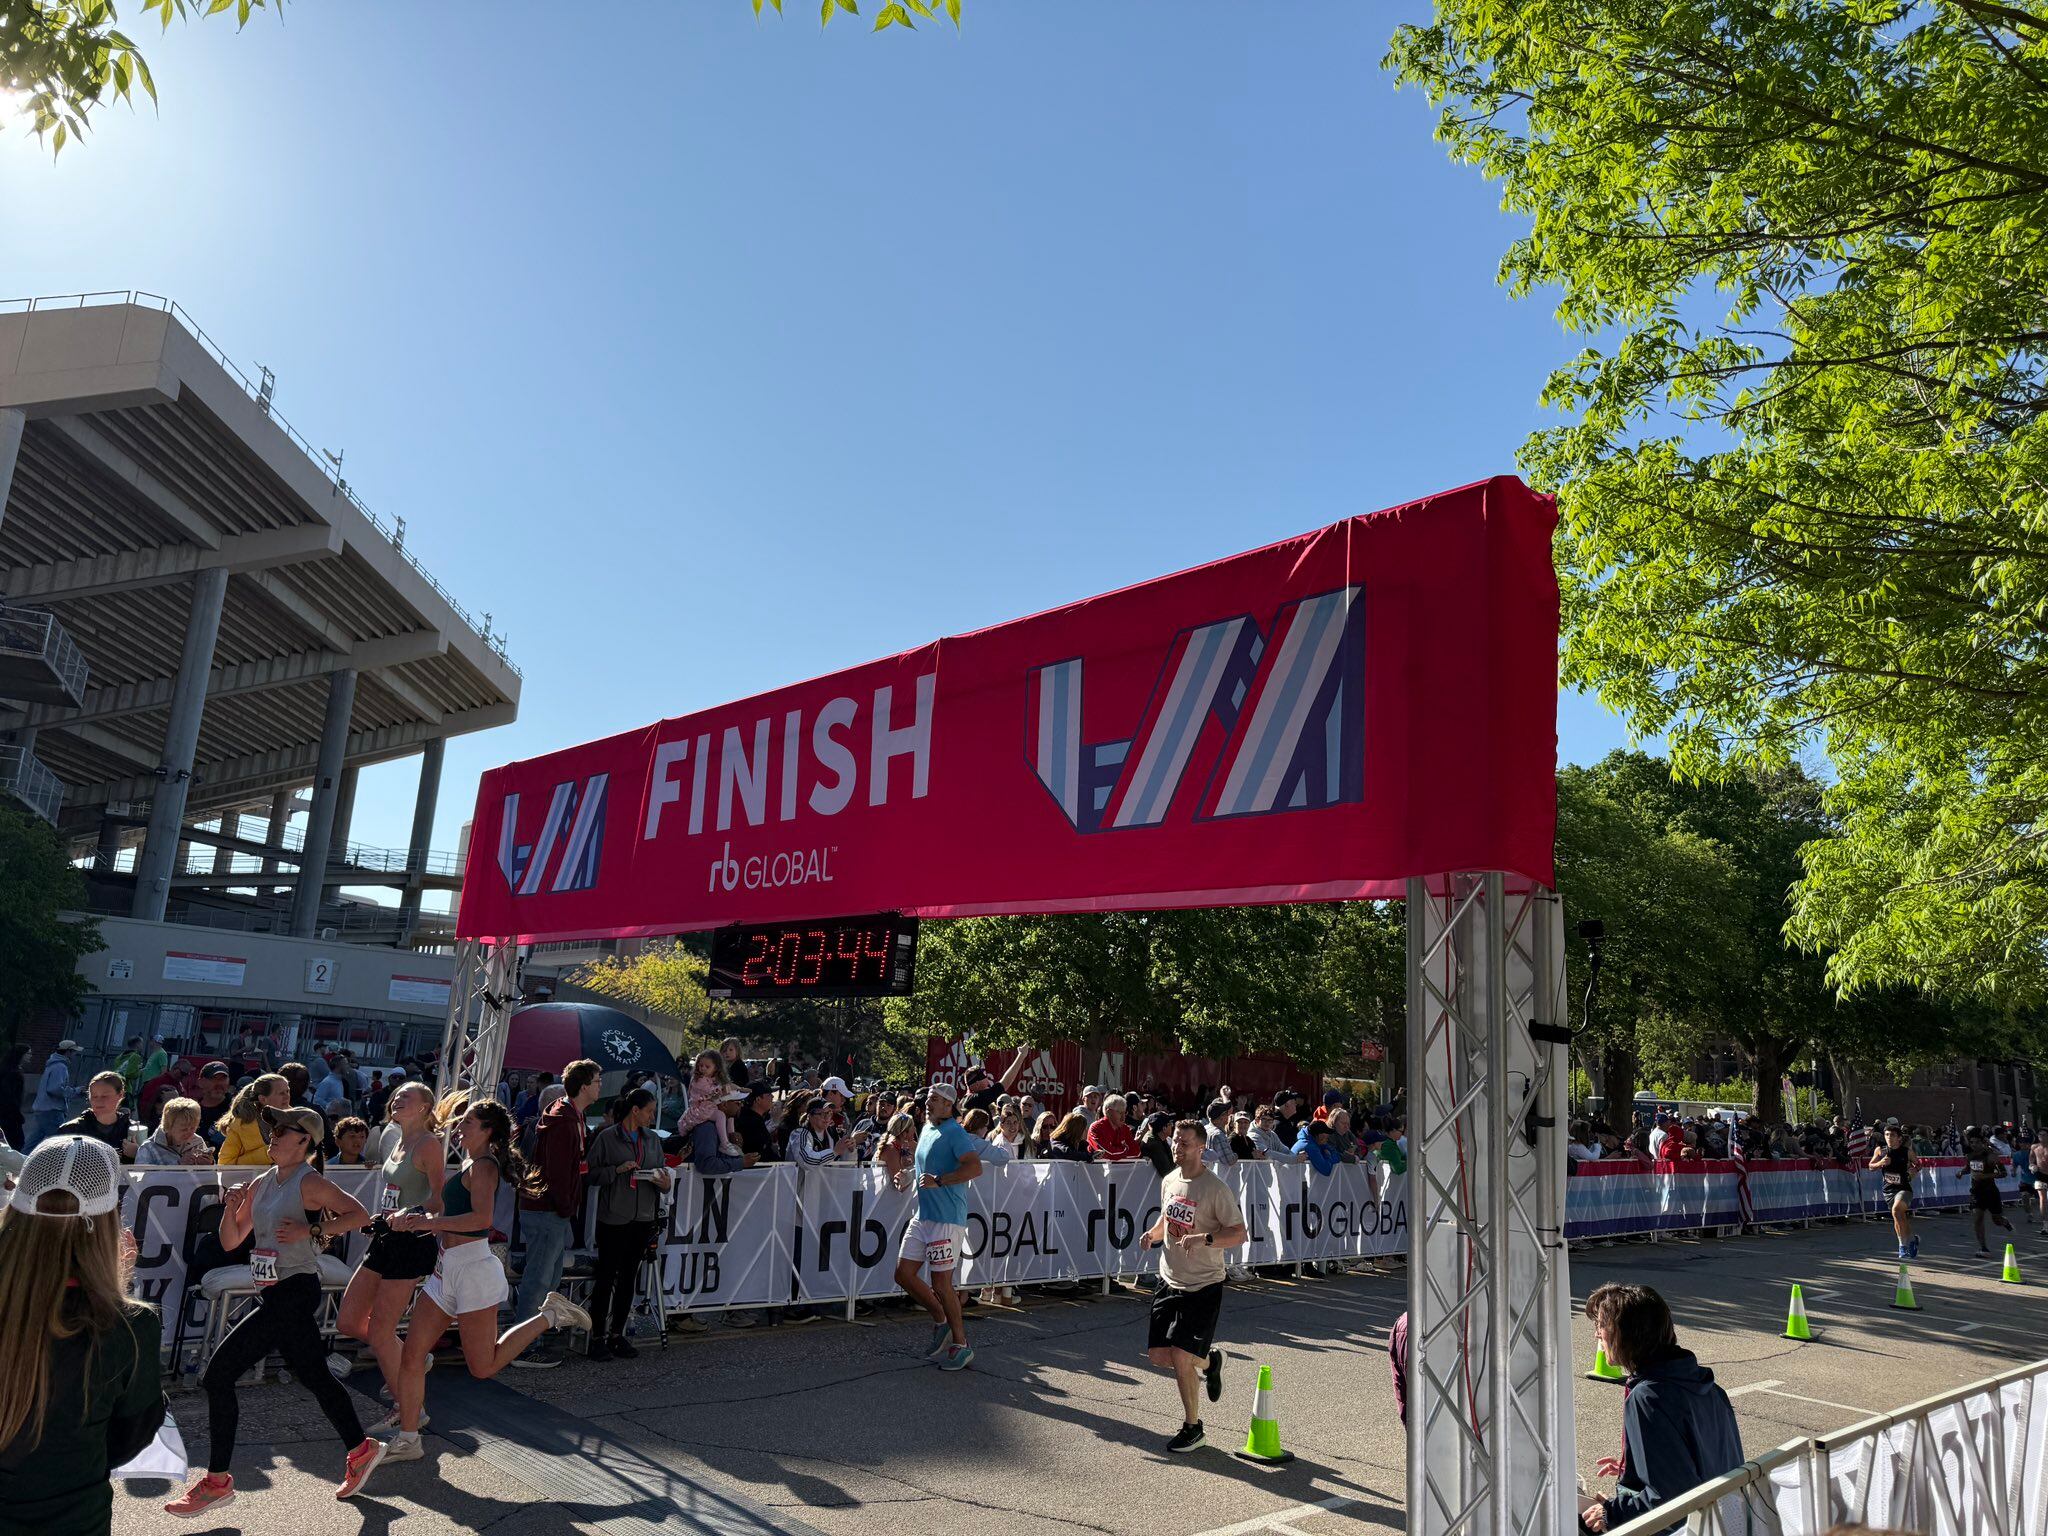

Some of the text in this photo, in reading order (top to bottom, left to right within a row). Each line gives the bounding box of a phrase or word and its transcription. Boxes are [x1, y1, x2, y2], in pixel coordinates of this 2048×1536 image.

[643, 671, 937, 841] FINISH
[708, 842, 740, 893] rb
[315, 964, 327, 982] 2
[601, 1030, 635, 1042] LINCOLN
[604, 1046, 642, 1065] MARATHON
[931, 1066, 994, 1090] adis
[1086, 1183, 1135, 1253] rb
[1166, 1204, 1194, 1223] 3045
[1285, 1181, 1323, 1241] rb
[1328, 1200, 1408, 1239] GLOBA
[818, 1190, 888, 1272] rb
